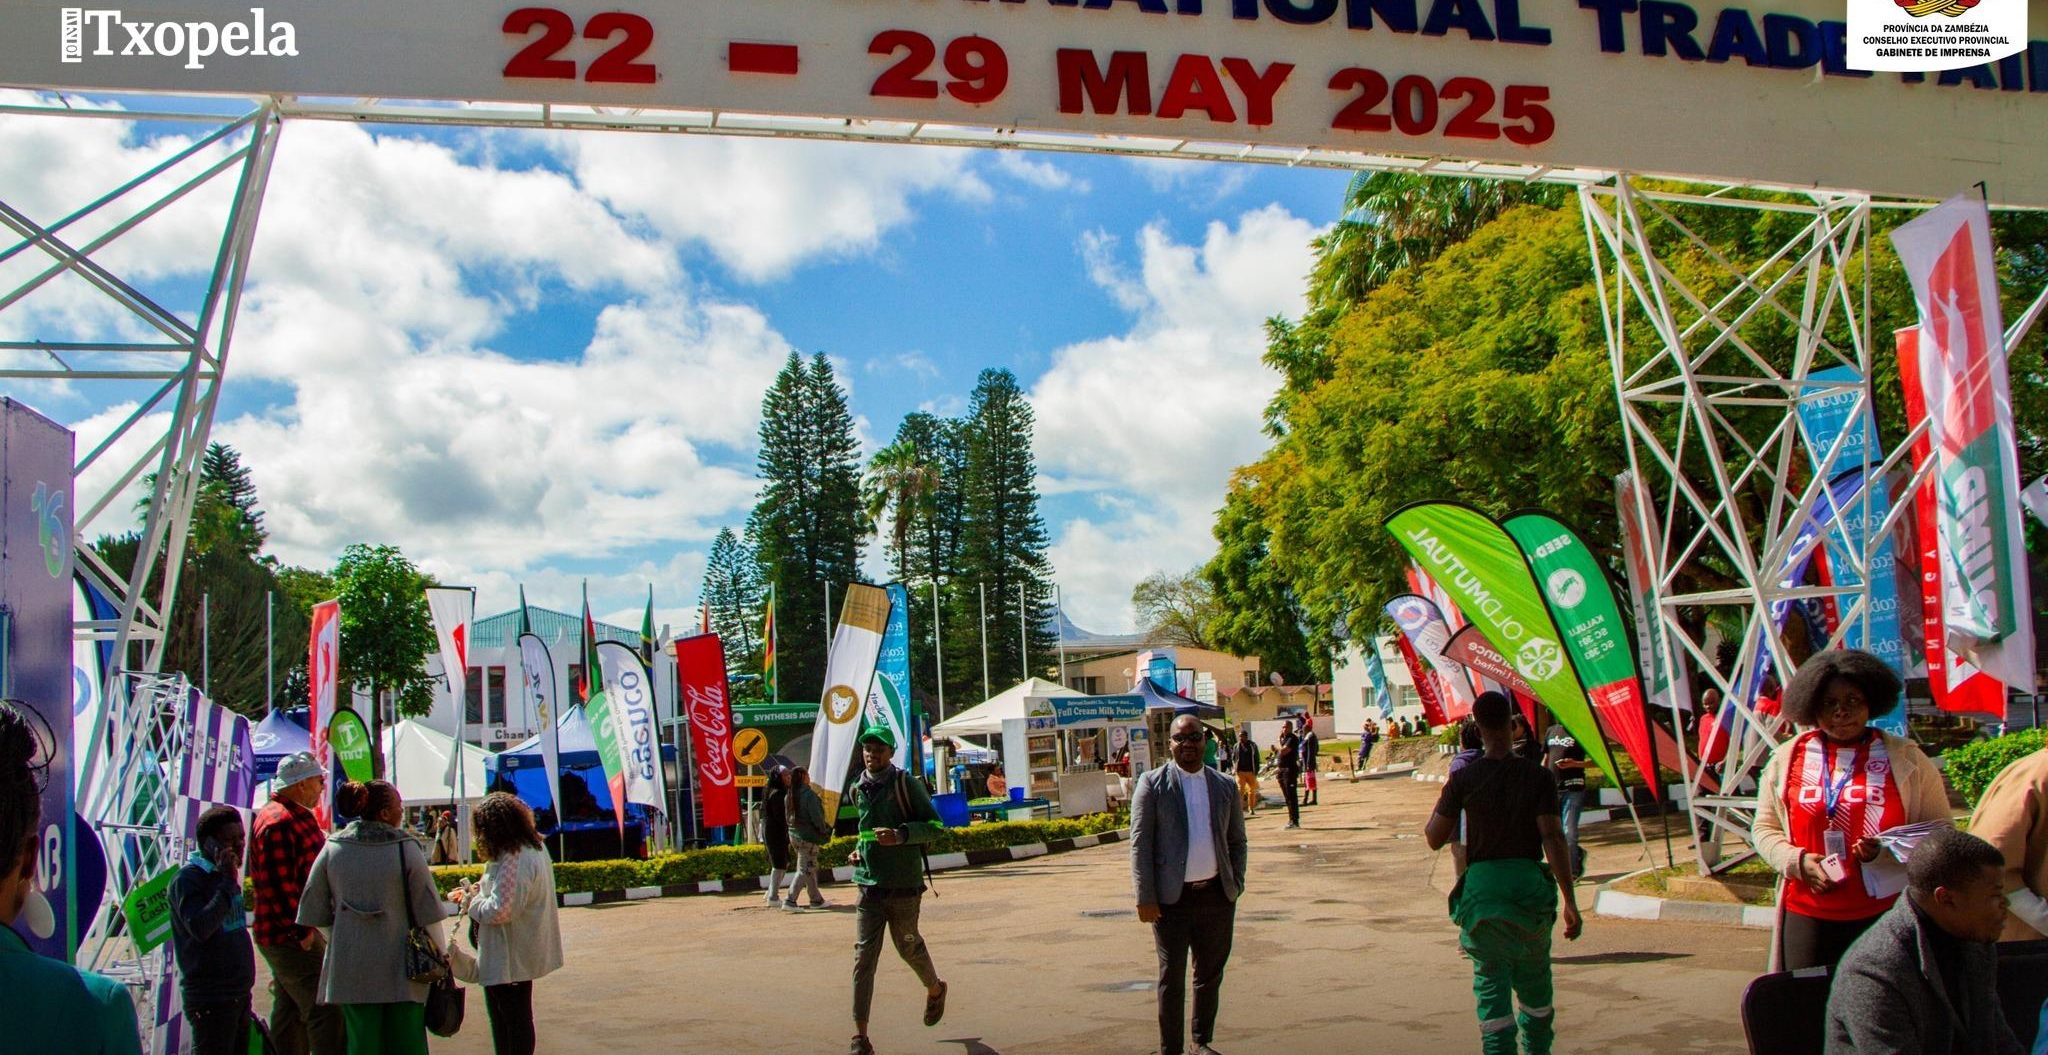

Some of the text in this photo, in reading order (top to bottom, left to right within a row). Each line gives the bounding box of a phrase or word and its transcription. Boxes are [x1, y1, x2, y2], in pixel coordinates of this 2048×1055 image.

[502, 7, 657, 84] 22
[867, 29, 1009, 103] 29
[1056, 47, 1296, 126] MAY
[1327, 66, 1556, 145] 2025
[754, 712, 798, 722] SYNTHESIS
[1058, 707, 1073, 717] Full
[1073, 707, 1098, 716] Cream
[1116, 706, 1143, 716] Powder
